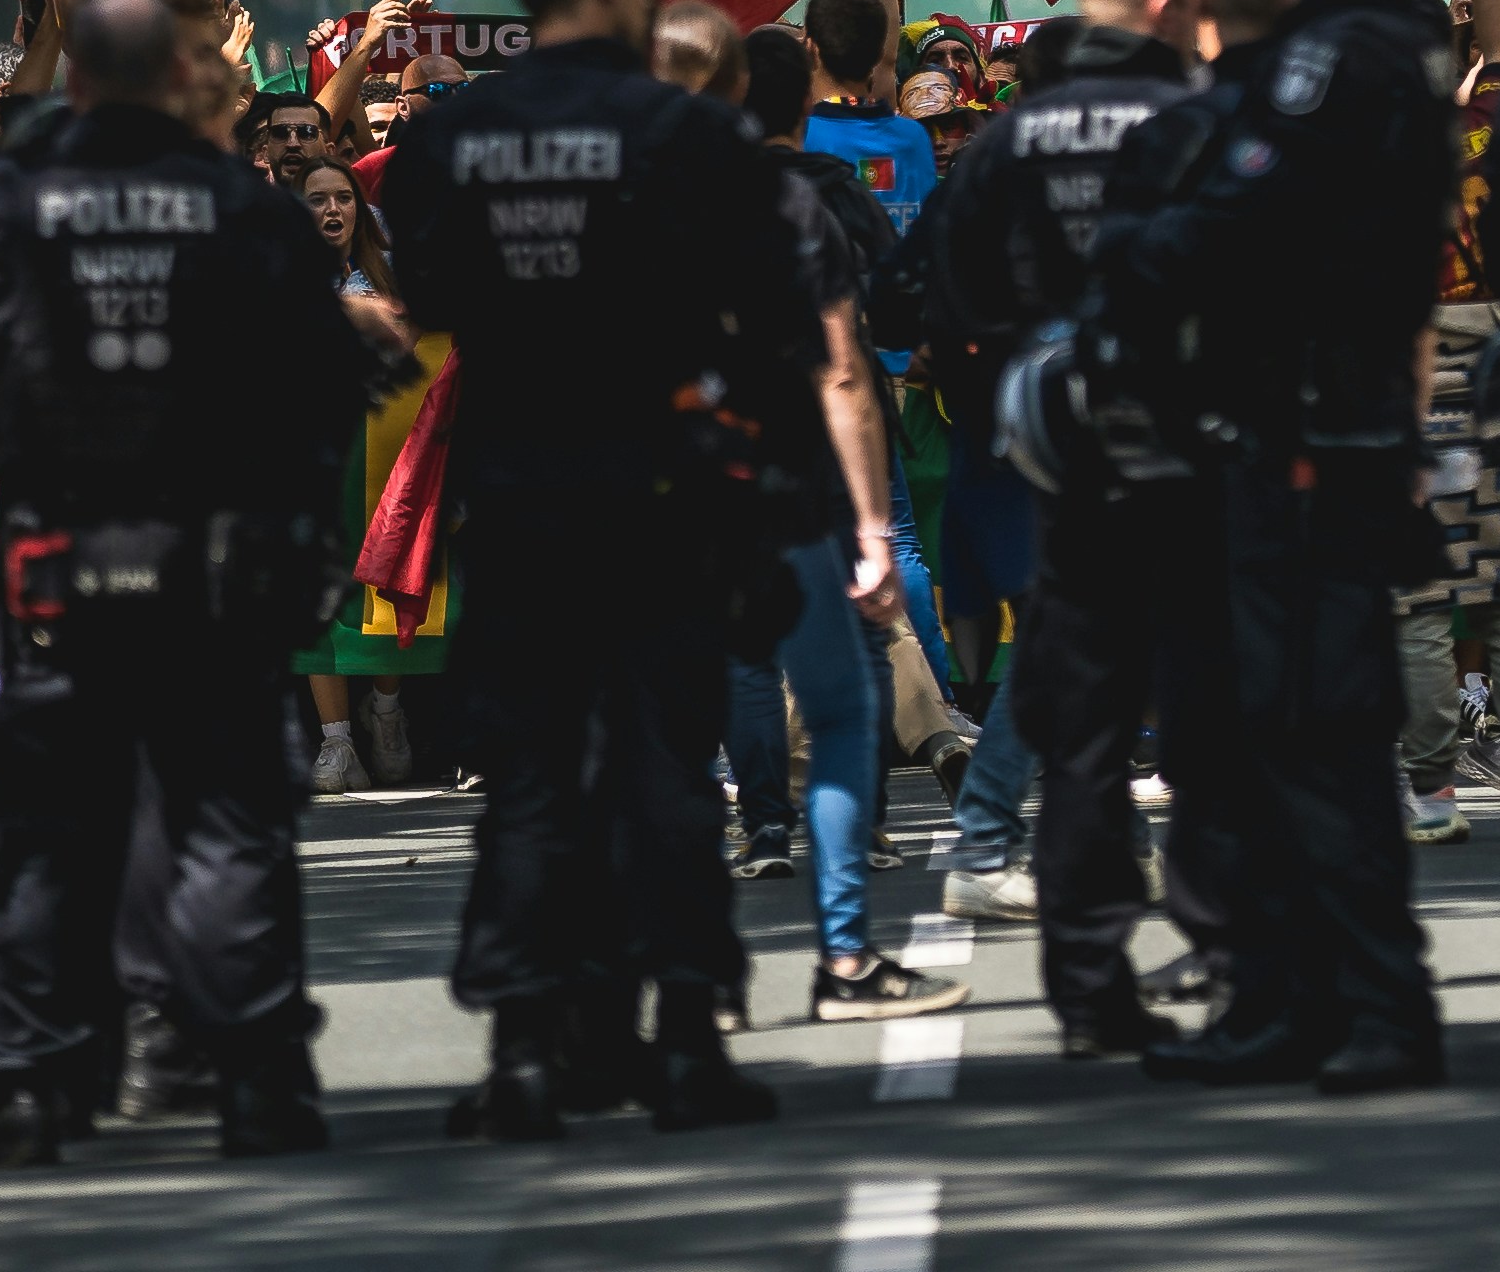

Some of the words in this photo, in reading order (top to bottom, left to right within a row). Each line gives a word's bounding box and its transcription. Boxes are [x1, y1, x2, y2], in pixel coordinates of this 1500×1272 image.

[452, 127, 624, 186] POLIZEI
[35, 183, 217, 240] POLIZEI
[487, 193, 589, 239] NRW
